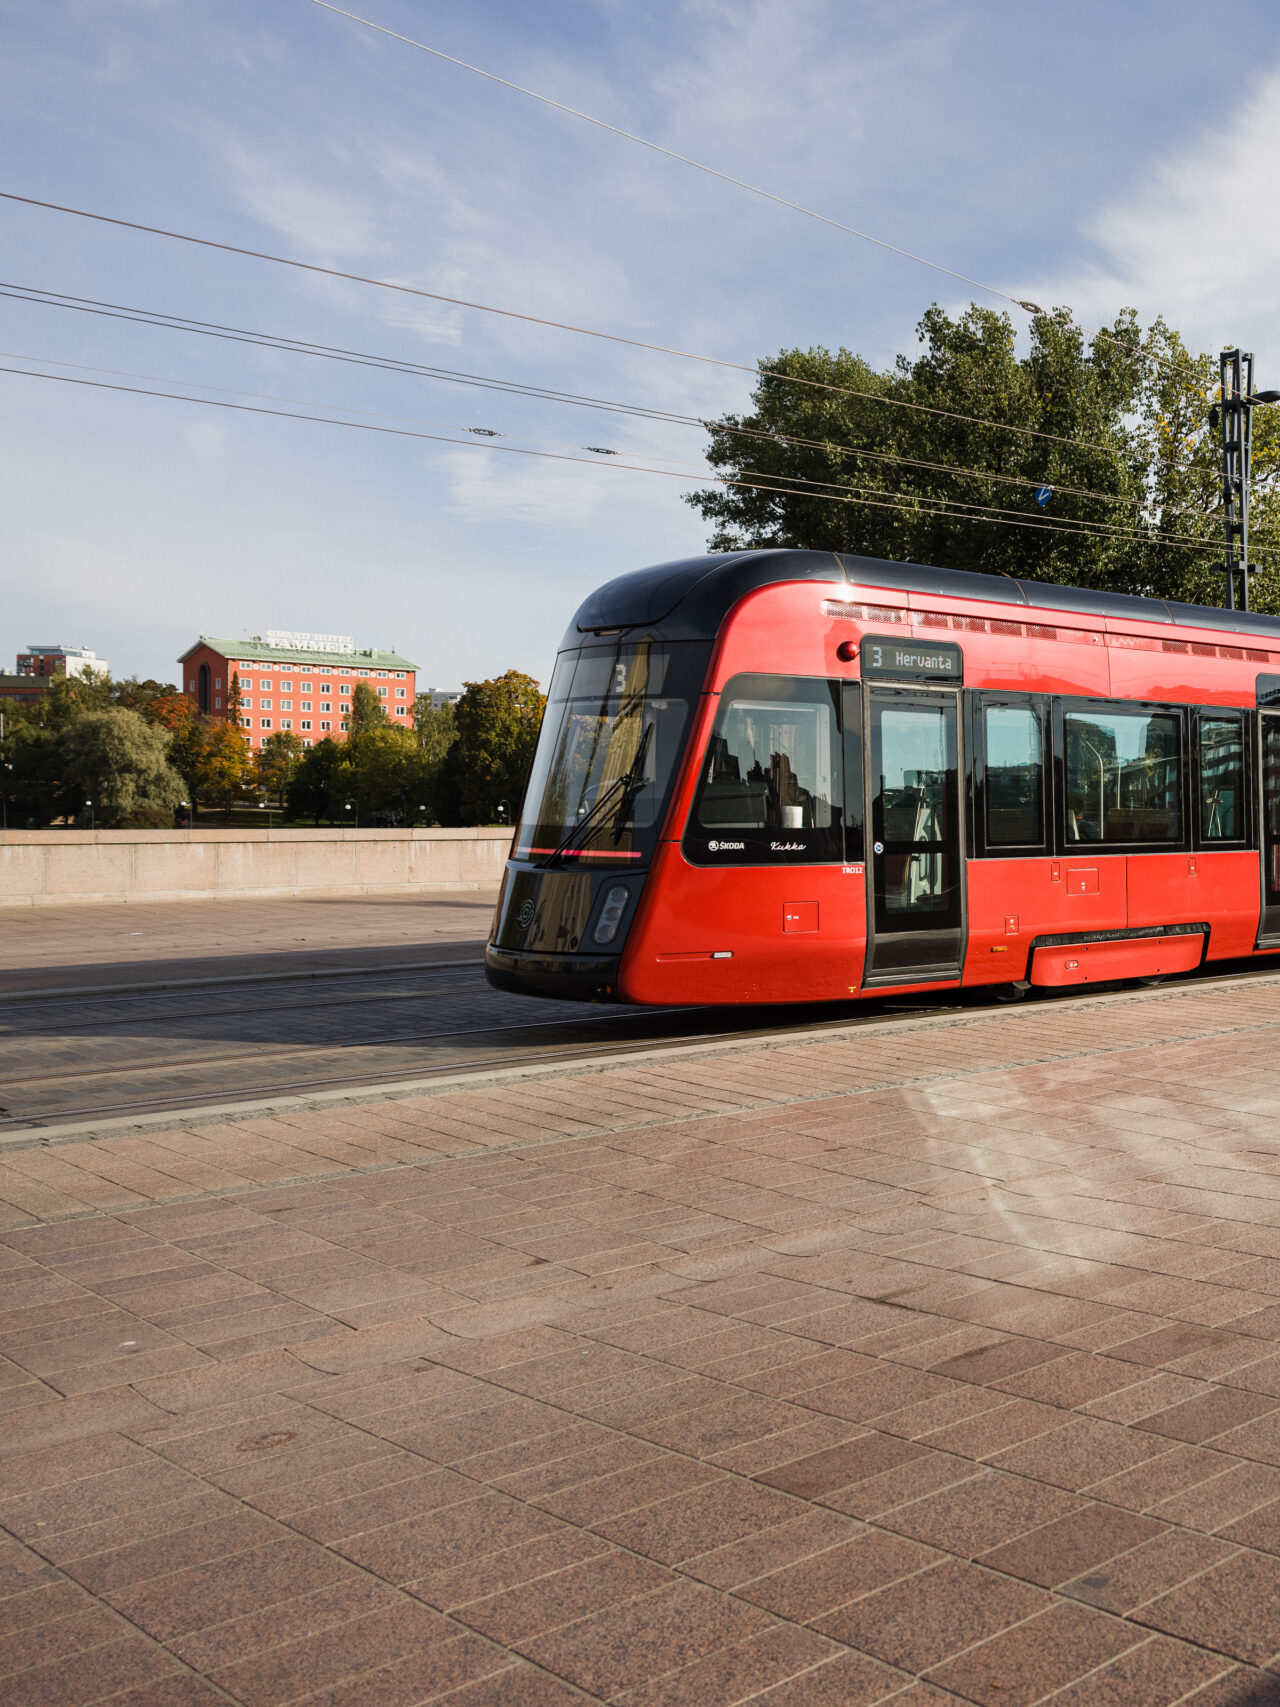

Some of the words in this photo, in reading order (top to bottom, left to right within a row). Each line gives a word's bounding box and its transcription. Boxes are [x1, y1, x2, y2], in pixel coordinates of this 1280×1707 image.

[872, 646, 882, 667] 3
[895, 651, 952, 670] Hervanta
[616, 664, 626, 692] 3
[719, 841, 745, 850] ŠKODA
[770, 841, 807, 851] Kukka
